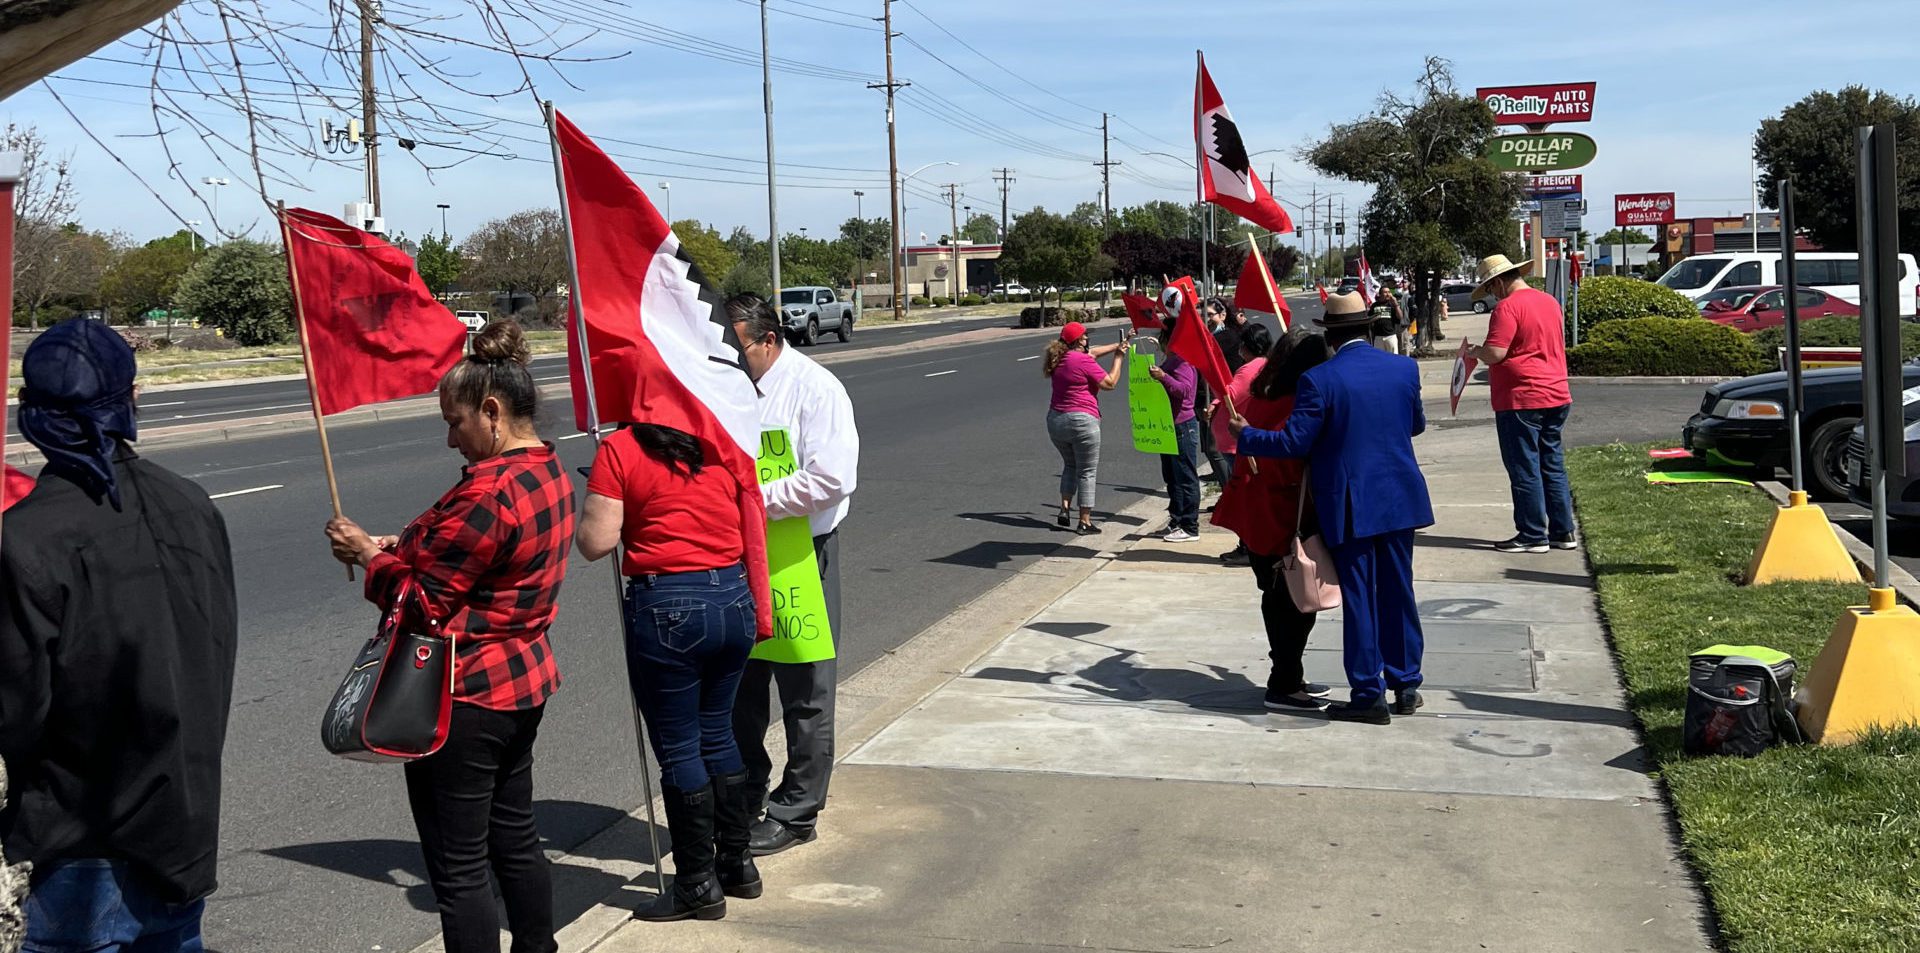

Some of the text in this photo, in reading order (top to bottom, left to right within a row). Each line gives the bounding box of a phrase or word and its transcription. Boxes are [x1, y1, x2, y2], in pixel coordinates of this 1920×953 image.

[1554, 90, 1586, 102] AUTO
[1486, 95, 1547, 114] O'Reilly
[1550, 102, 1589, 114] PARTS
[1501, 138, 1573, 153] DOLLAR
[1515, 153, 1558, 166] TREE
[1538, 175, 1577, 186] FREIGHT
[1617, 197, 1654, 212] Wendy's
[772, 586, 800, 611] DE
[772, 613, 820, 641] NOS
